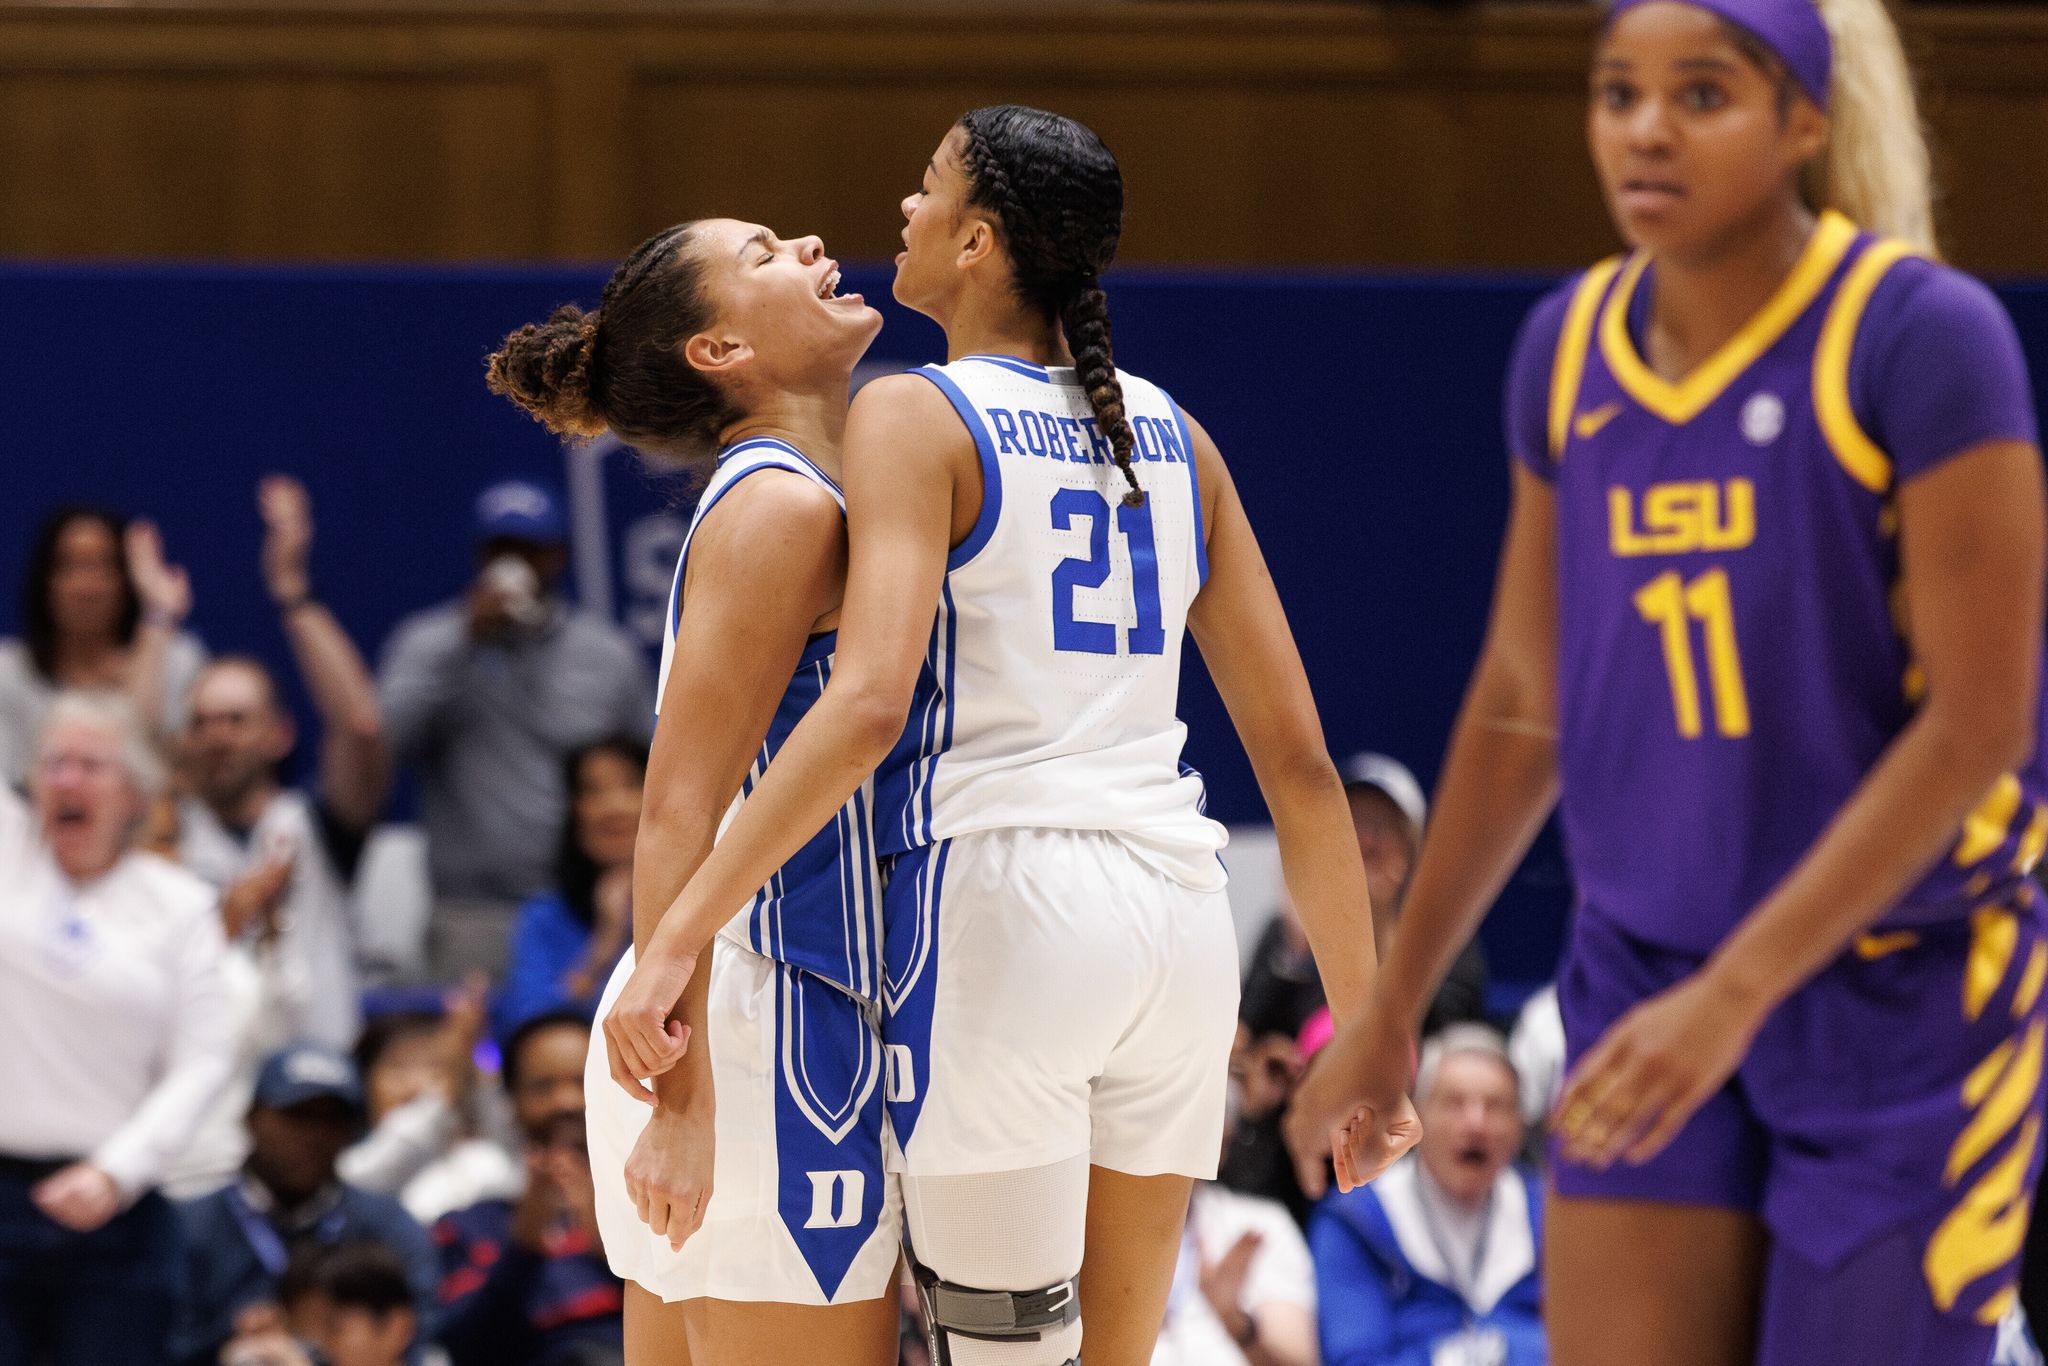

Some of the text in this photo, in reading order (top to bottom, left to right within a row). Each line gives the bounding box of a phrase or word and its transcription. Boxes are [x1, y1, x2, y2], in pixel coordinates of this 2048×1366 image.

[986, 408, 1187, 465] ROBERON
[1607, 475, 1756, 557] LSU
[1050, 487, 1165, 655] 21
[1632, 566, 1750, 739] 11
[803, 1169, 865, 1229] D
